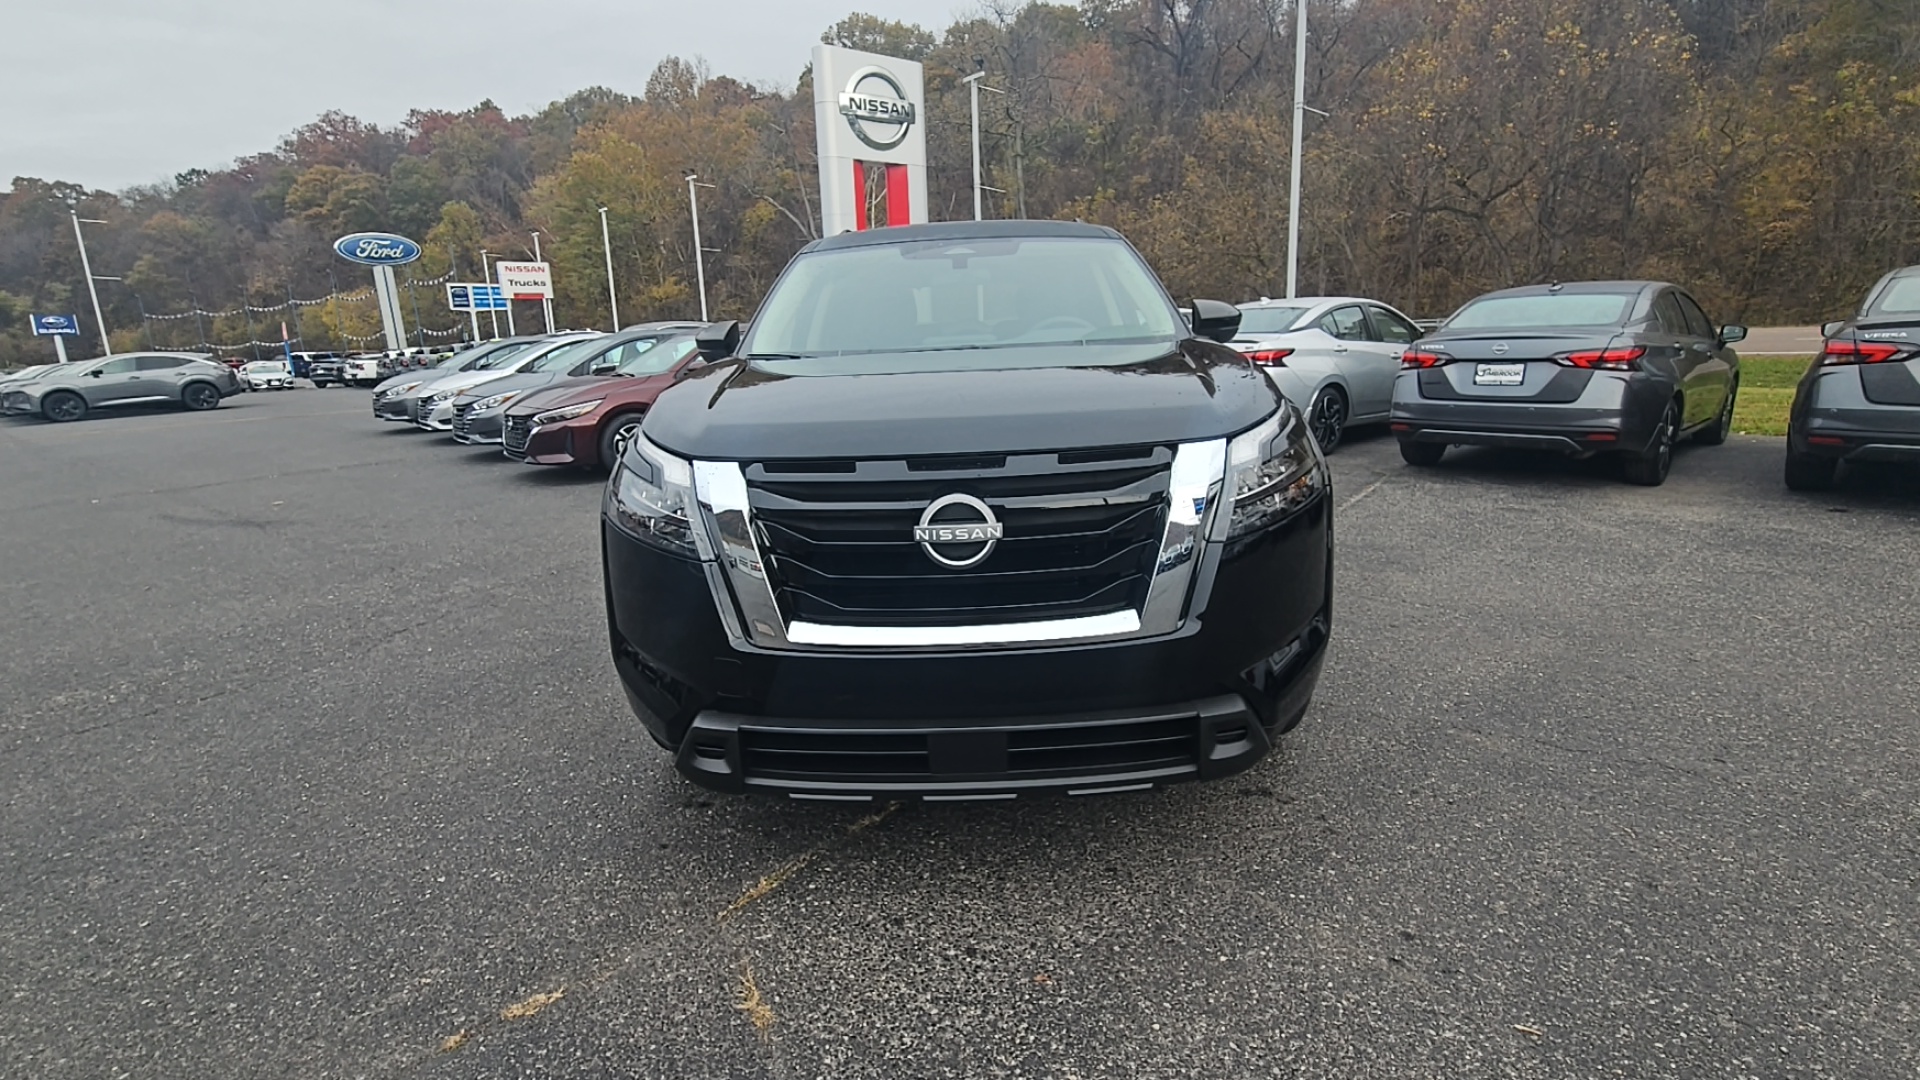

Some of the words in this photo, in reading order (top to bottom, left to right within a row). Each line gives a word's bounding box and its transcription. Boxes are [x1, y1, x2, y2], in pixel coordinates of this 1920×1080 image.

[848, 97, 910, 118] NISSAN
[356, 239, 404, 258] Ford
[504, 265, 545, 273] NISSAN
[507, 279, 547, 287] Trucks
[1864, 331, 1908, 339] VERSA
[915, 526, 1001, 541] NISSAN
